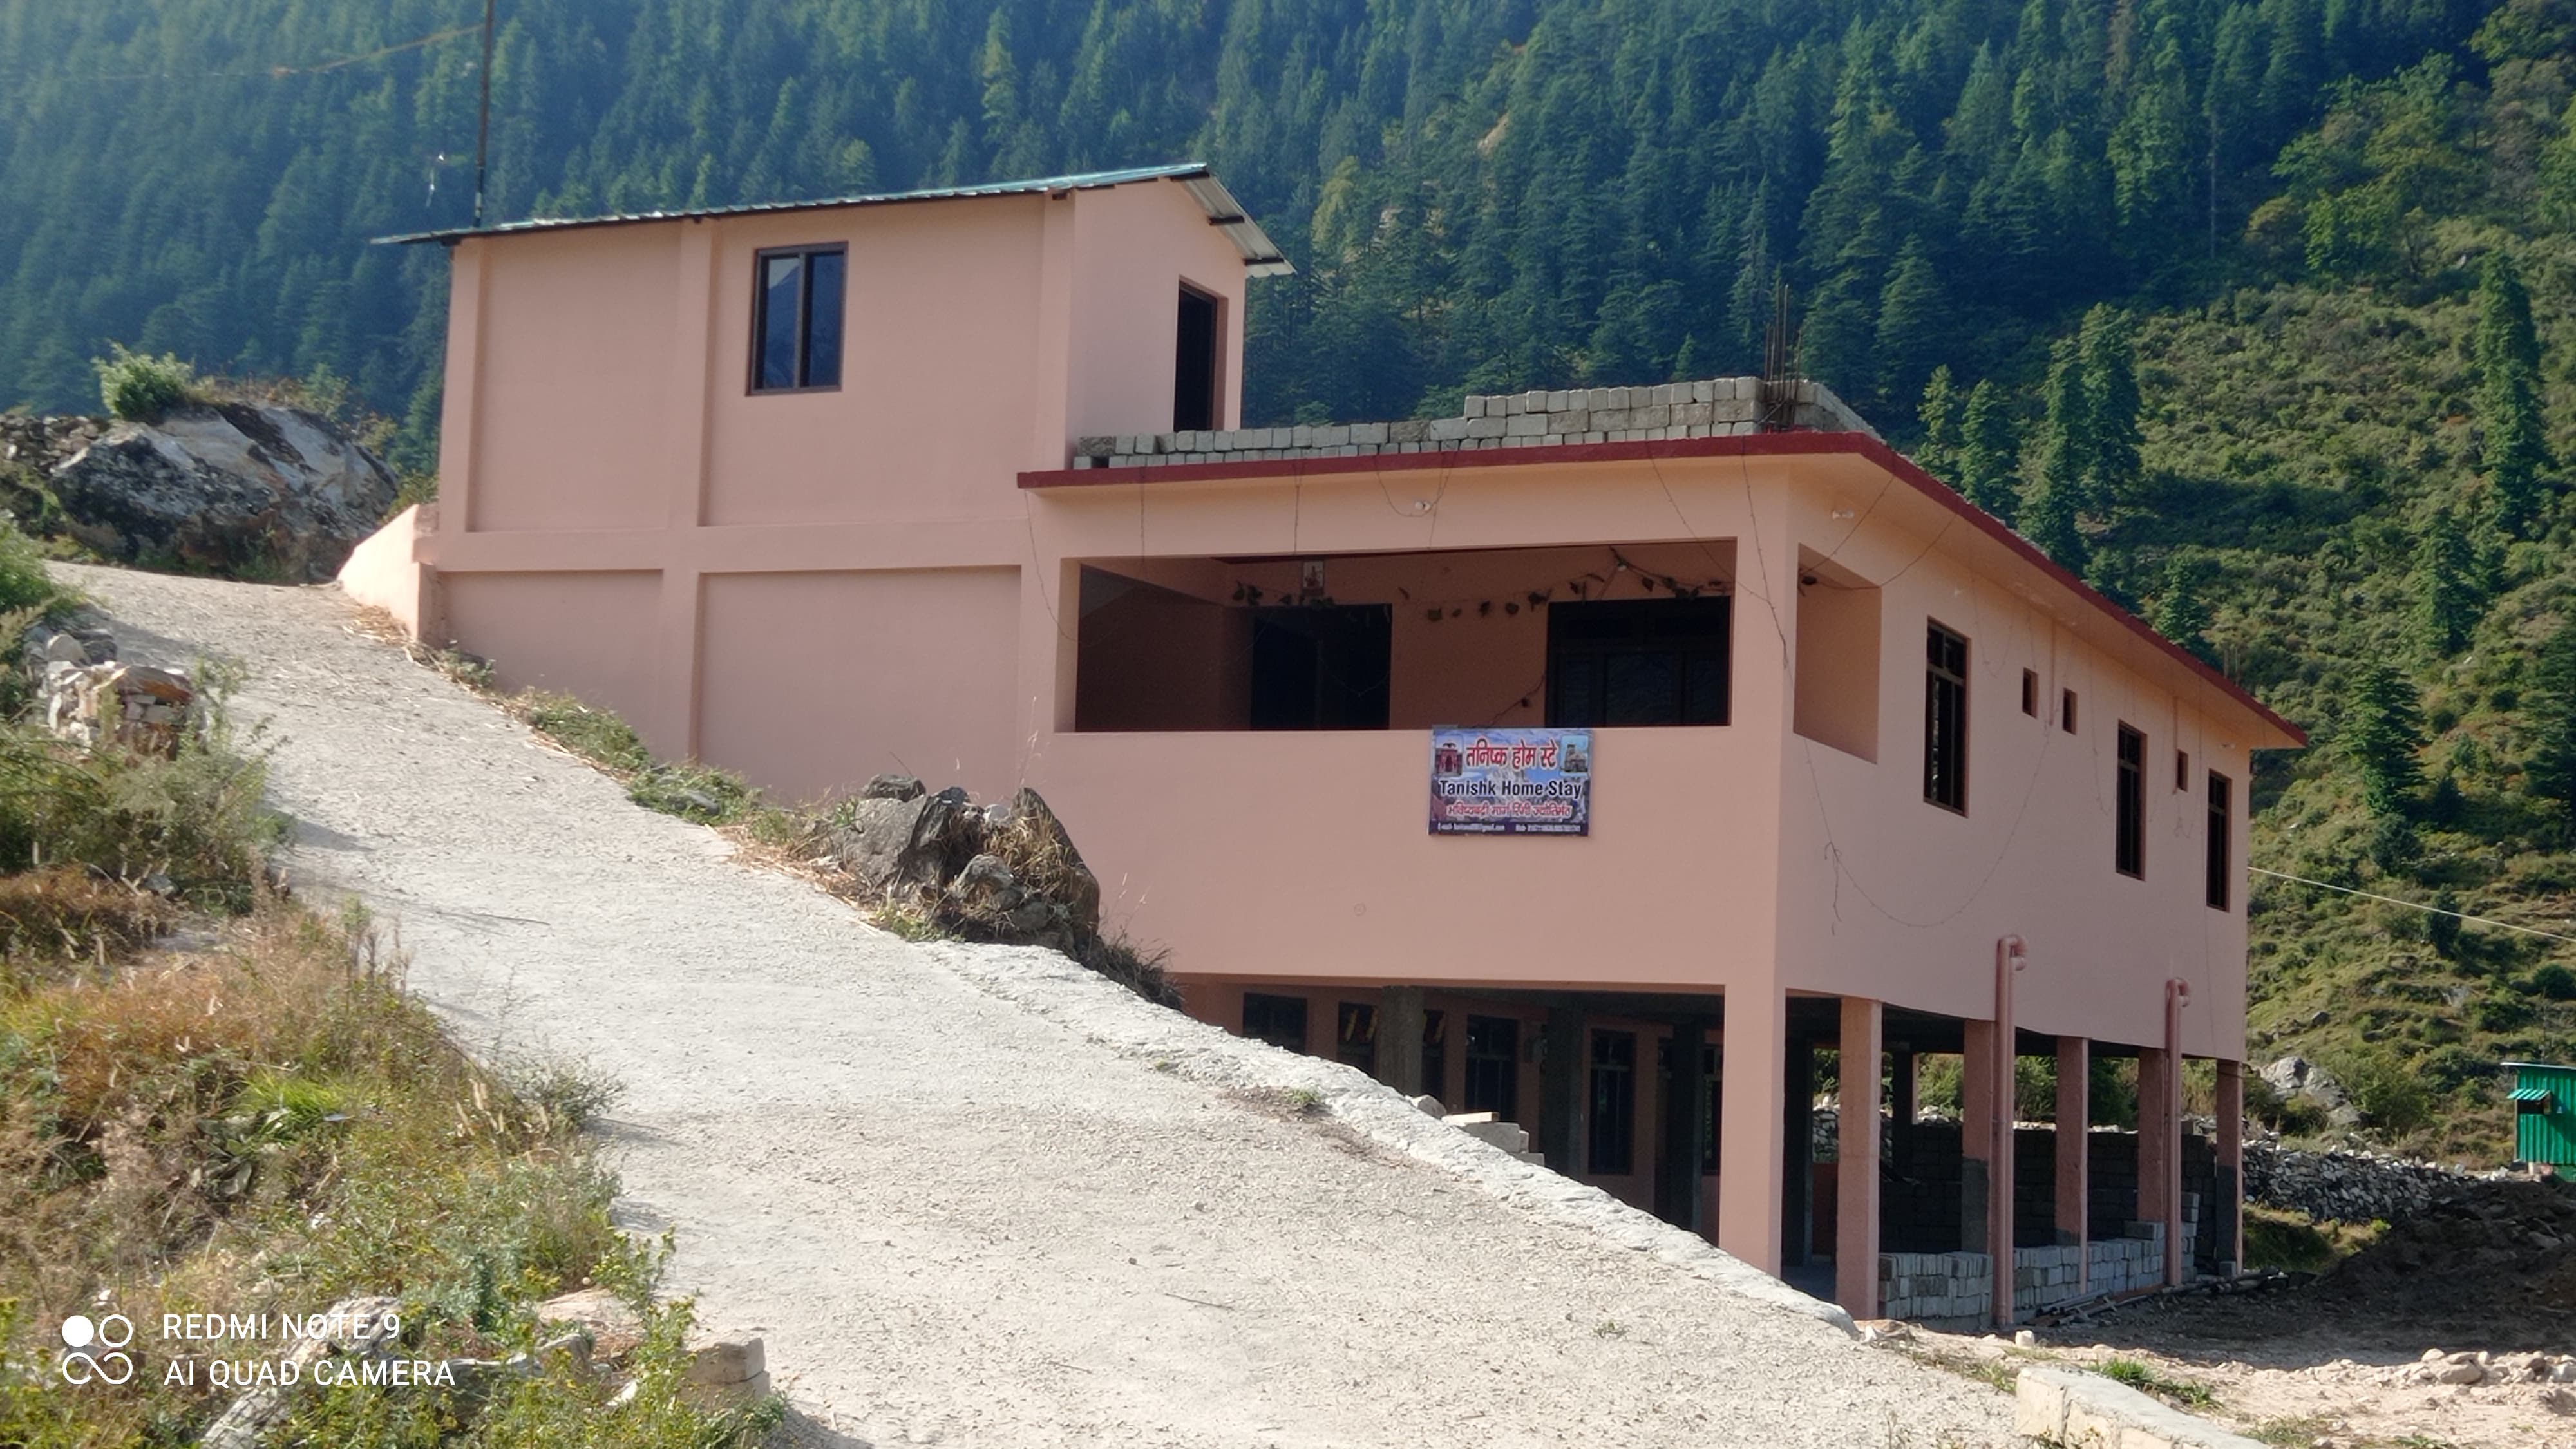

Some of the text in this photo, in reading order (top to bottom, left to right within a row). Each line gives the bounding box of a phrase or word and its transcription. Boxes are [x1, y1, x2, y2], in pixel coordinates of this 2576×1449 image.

[1466, 738, 1557, 769] तनिष्क होम स्टे
[1440, 781, 1581, 799] Tanishk Home Stay
